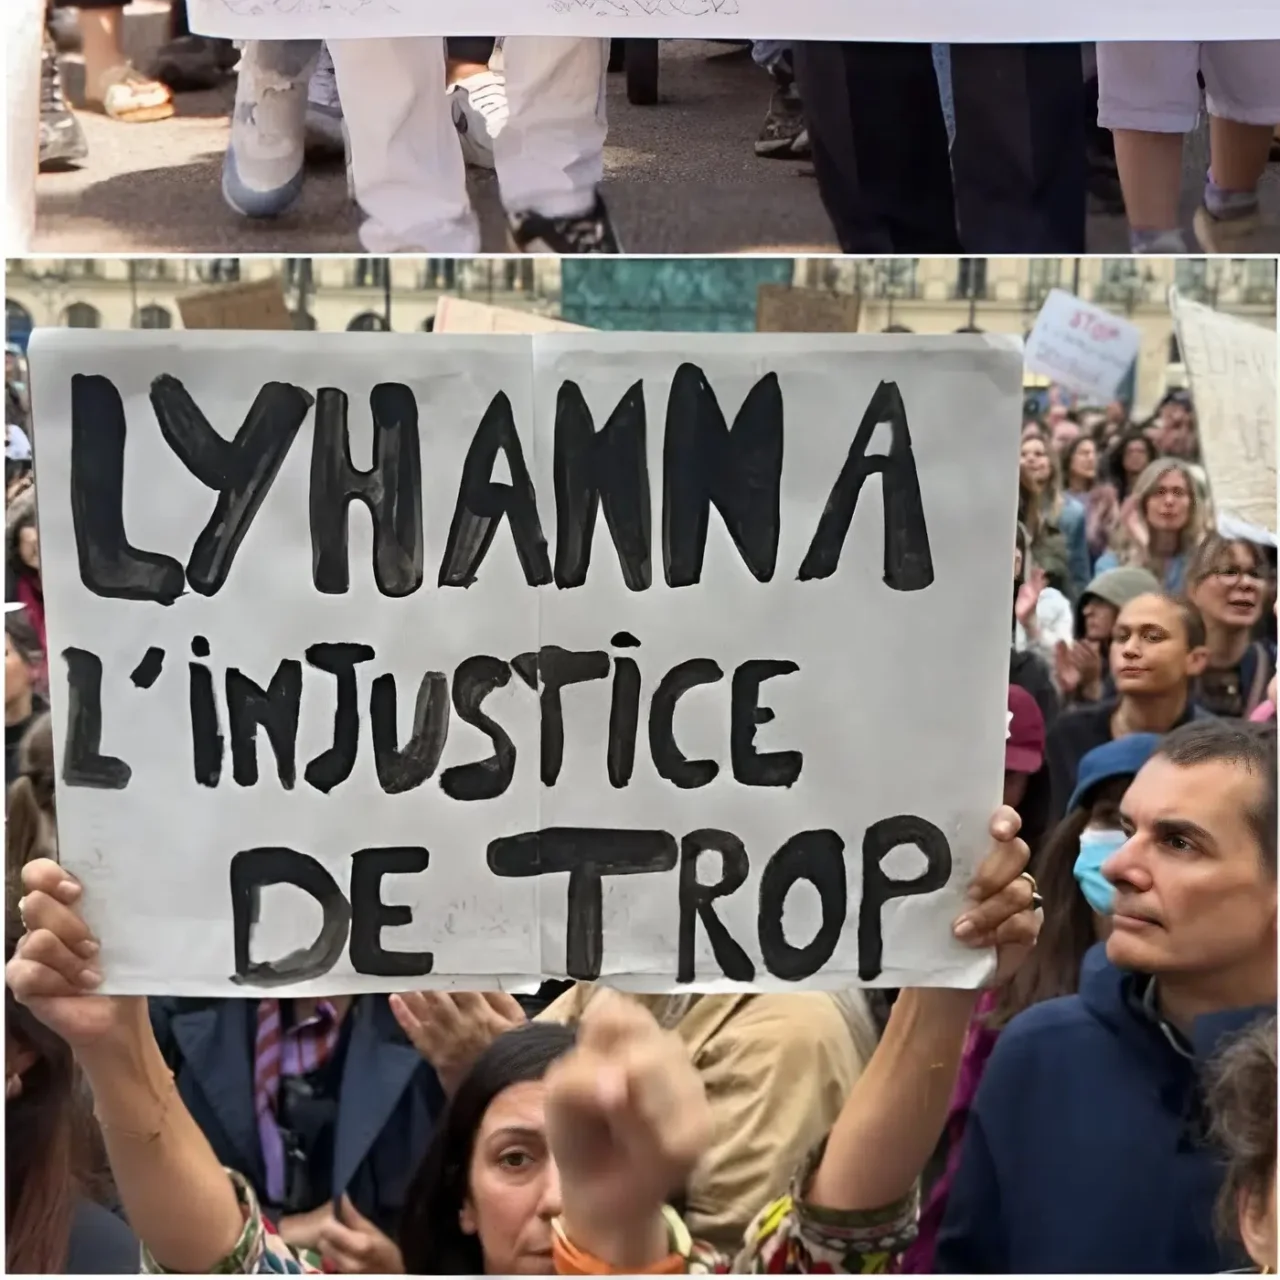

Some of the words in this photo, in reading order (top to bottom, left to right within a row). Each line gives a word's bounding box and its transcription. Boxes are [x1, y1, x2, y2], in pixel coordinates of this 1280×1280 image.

[70, 363, 935, 607] LYHANNA
[229, 846, 435, 985] DE
[486, 814, 953, 984] TROP
